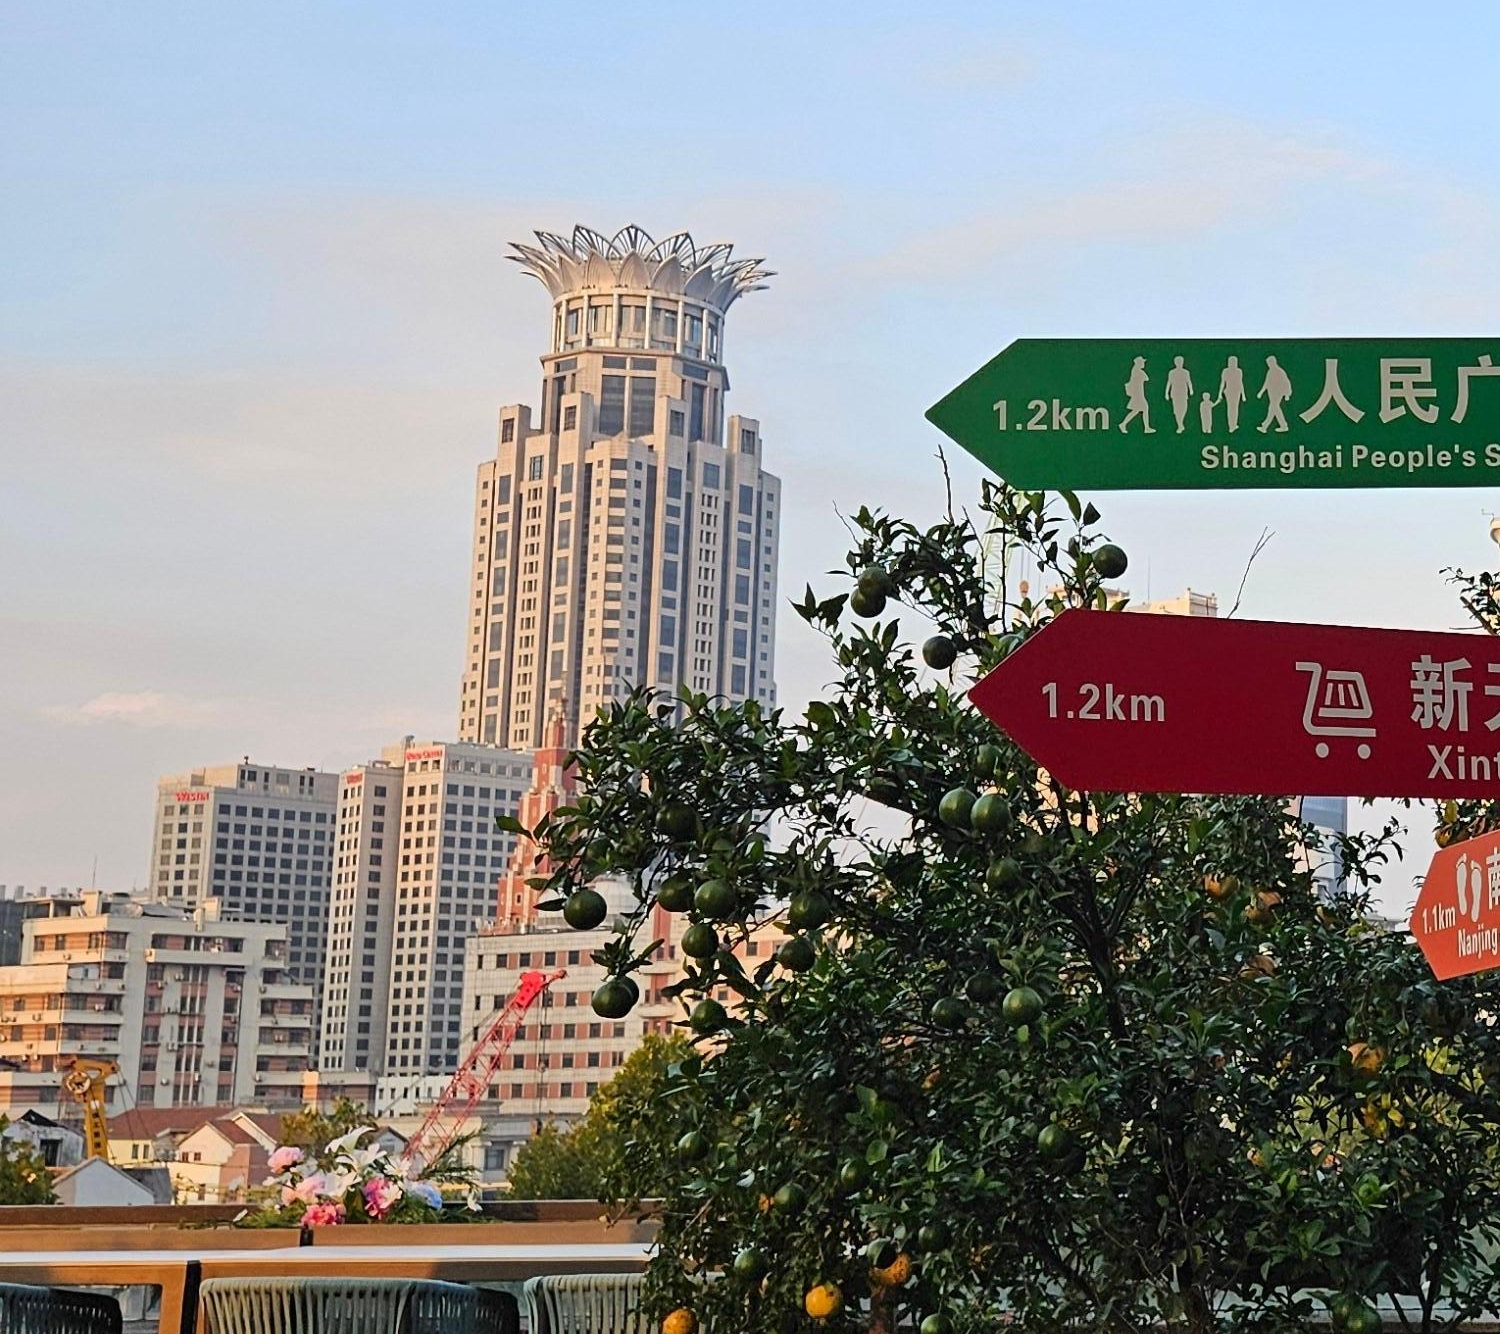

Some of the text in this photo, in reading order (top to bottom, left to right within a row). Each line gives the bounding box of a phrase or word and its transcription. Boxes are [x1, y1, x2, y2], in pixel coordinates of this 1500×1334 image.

[991, 399, 1110, 431] 1.2km
[1201, 444, 1342, 473] Shanghai
[1352, 444, 1477, 472] People's
[1041, 682, 1167, 722] 1.2km
[1422, 902, 1456, 934] 1.1km
[1457, 921, 1498, 959] Nanjing
